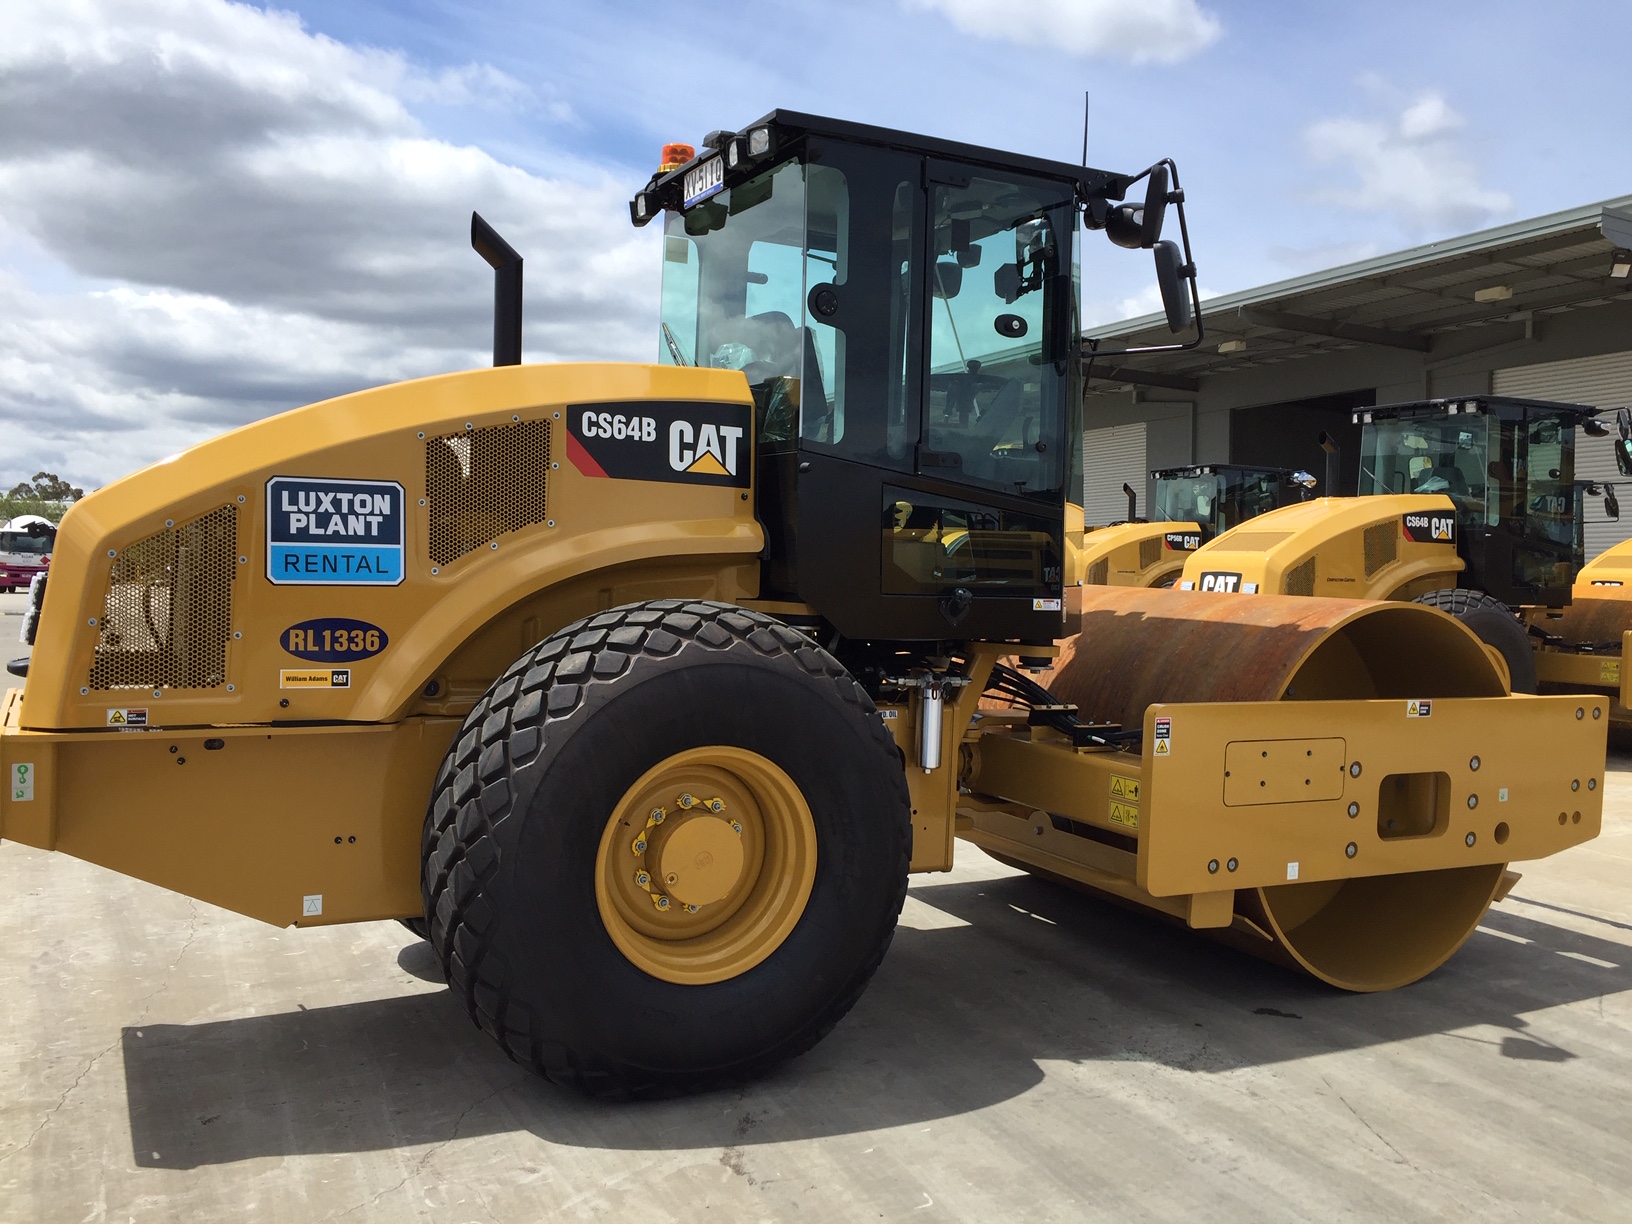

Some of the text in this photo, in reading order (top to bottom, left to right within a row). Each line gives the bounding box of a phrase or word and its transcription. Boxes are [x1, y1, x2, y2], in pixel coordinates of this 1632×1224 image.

[582, 411, 743, 476] CS64B CAT
[282, 490, 391, 515] LUXTON
[290, 513, 383, 536] PLANT
[1406, 515, 1454, 539] CS64B CAT
[1184, 535, 1200, 549] CAT
[284, 554, 389, 574] RENTAL
[1202, 574, 1238, 593] CAT
[289, 629, 380, 652] RL1336
[333, 674, 348, 683] CAT
